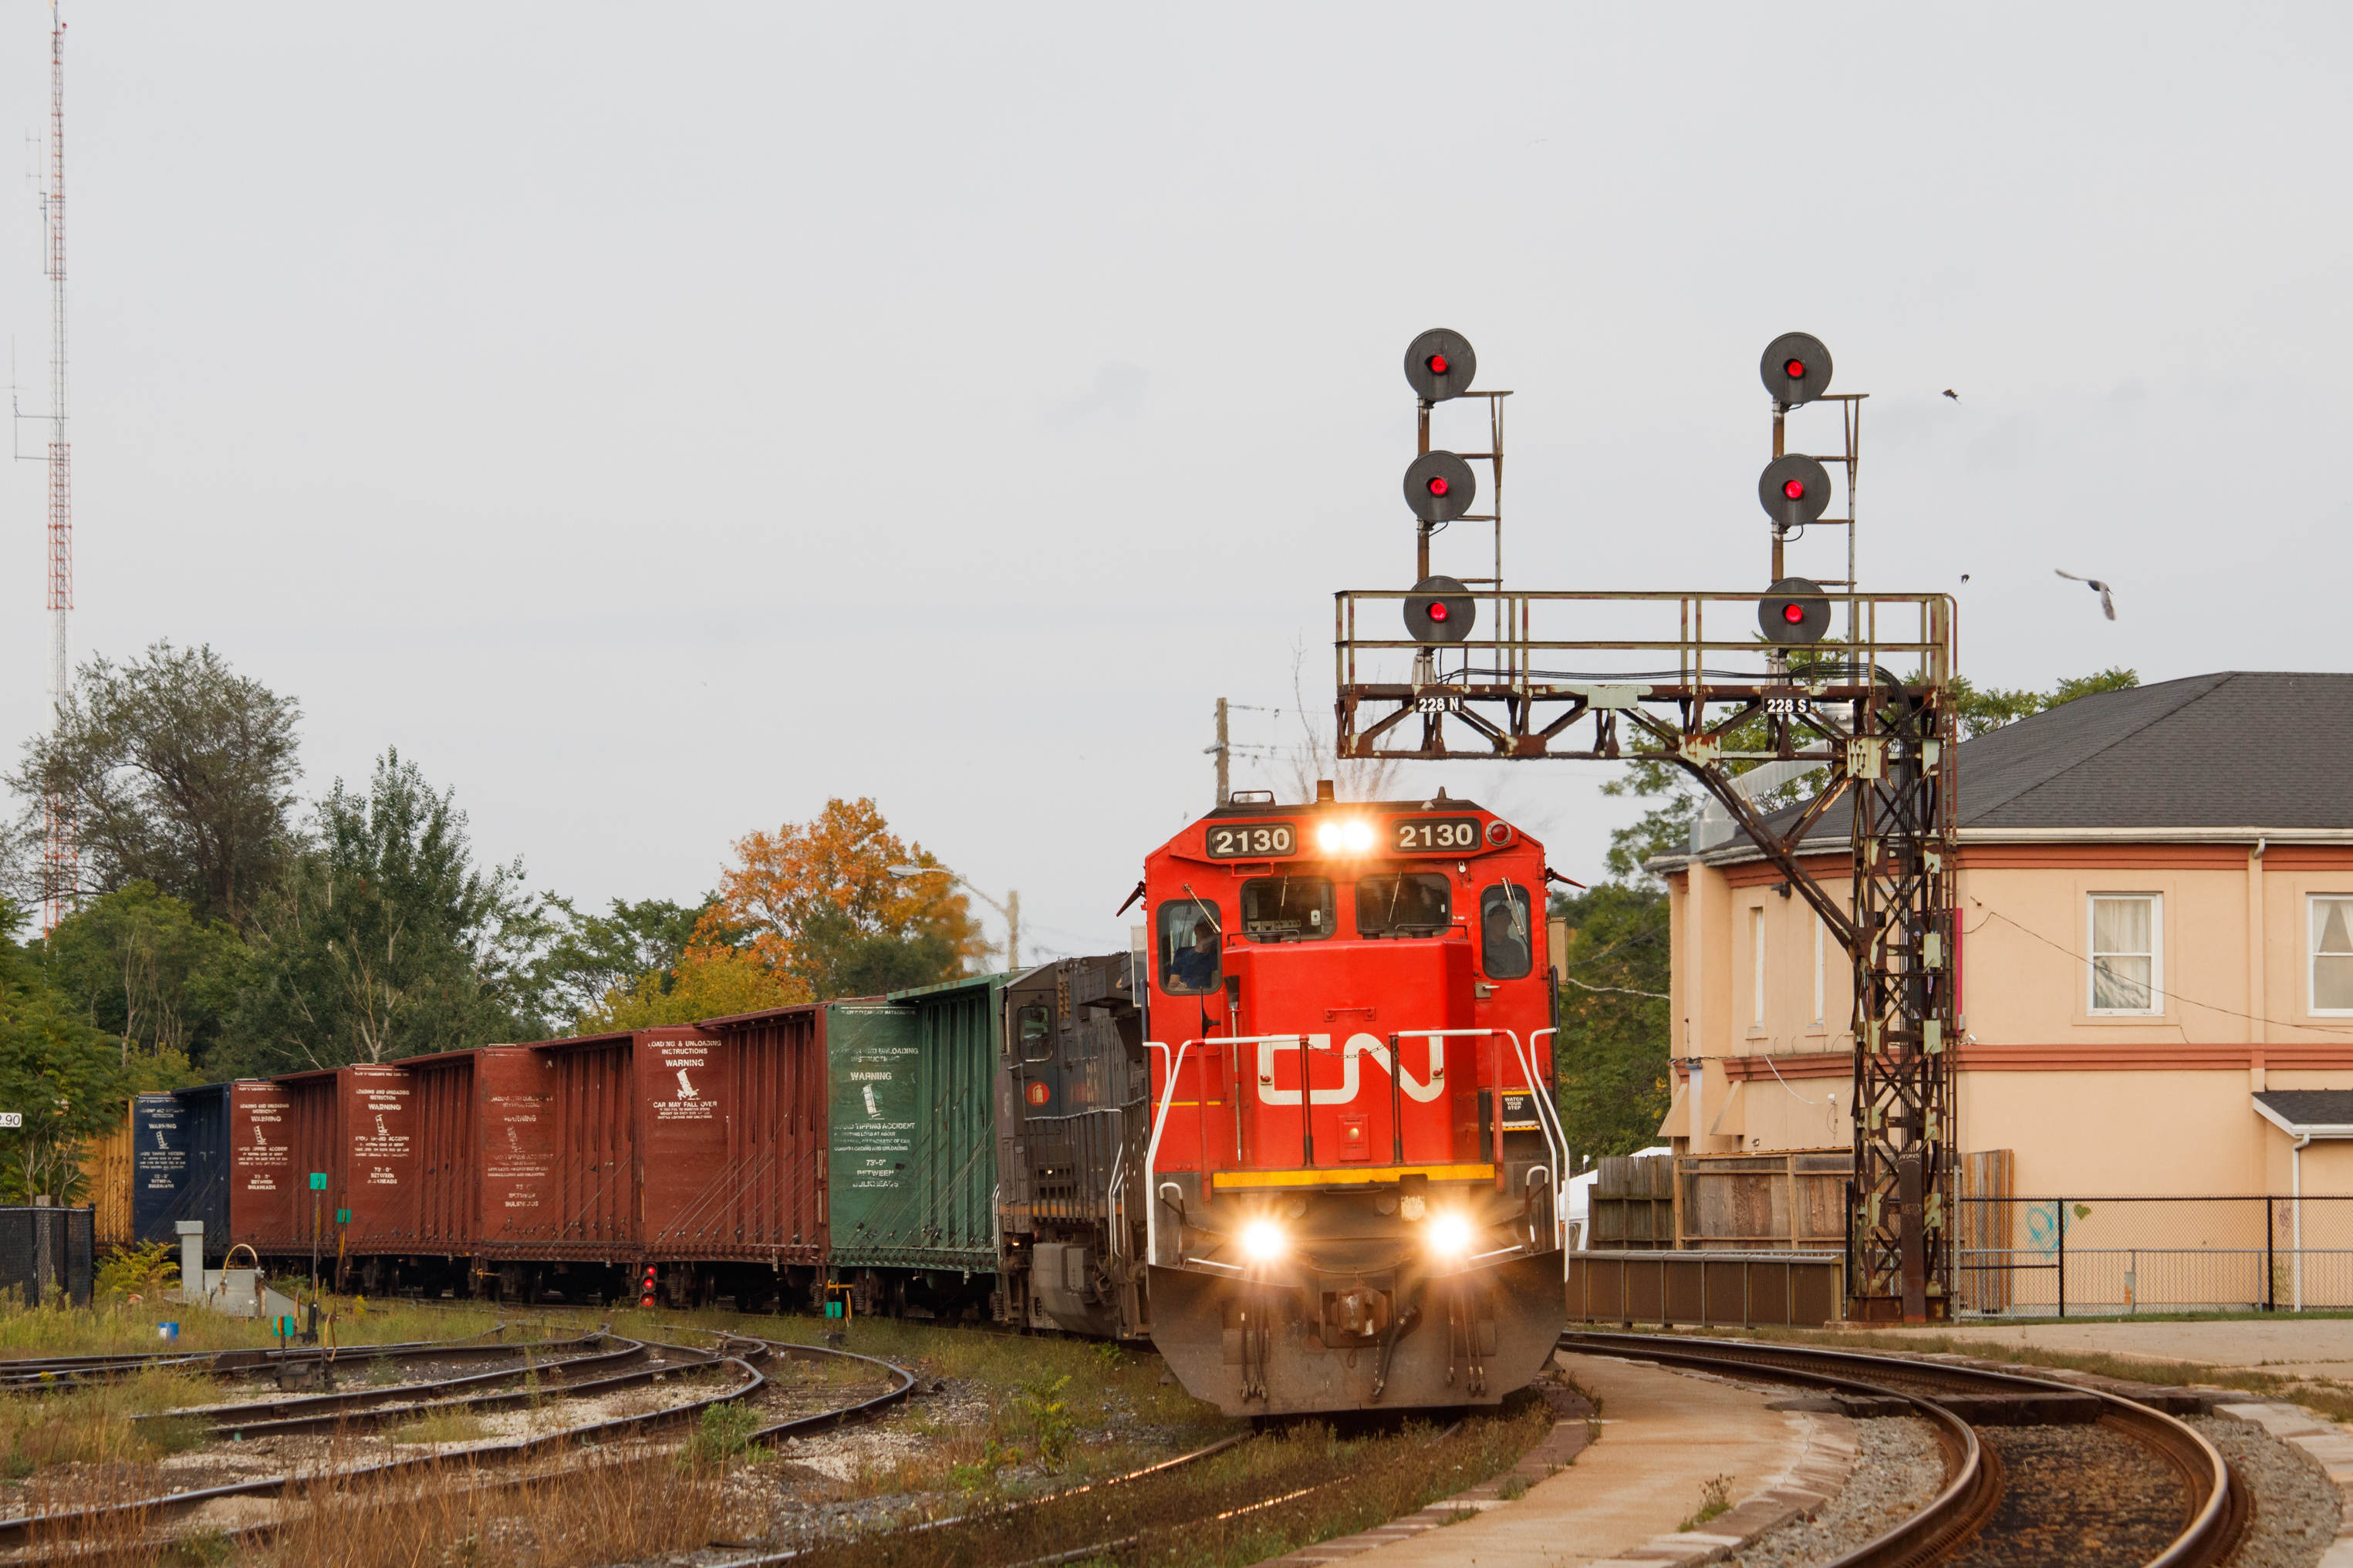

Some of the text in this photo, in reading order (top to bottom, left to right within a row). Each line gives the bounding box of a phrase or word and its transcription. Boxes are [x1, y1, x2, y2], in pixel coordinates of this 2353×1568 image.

[1419, 697, 1459, 712] 228 N
[1767, 699, 1807, 713] 228 S
[1217, 828, 1290, 854] 2130
[1399, 824, 1473, 848] 2130
[850, 1072, 892, 1081] WARNING
[1258, 1033, 1445, 1105] CN
